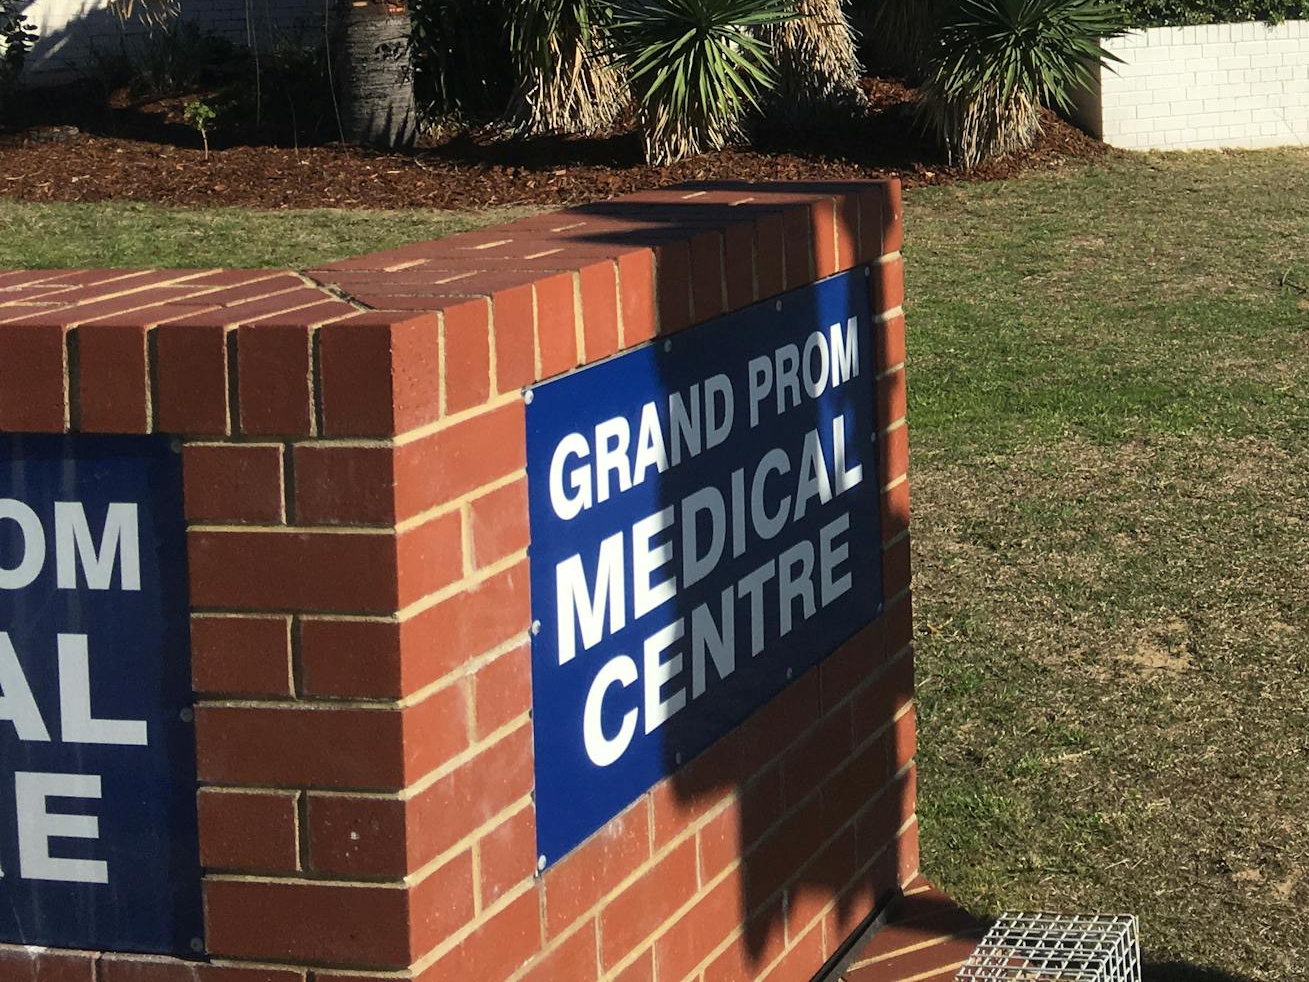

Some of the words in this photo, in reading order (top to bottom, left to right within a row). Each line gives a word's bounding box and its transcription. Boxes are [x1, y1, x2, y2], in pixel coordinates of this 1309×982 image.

[549, 373, 735, 521] GRAND
[748, 316, 860, 428] PROM
[555, 414, 863, 666] MEDICAL
[583, 512, 853, 767] CENTRE
